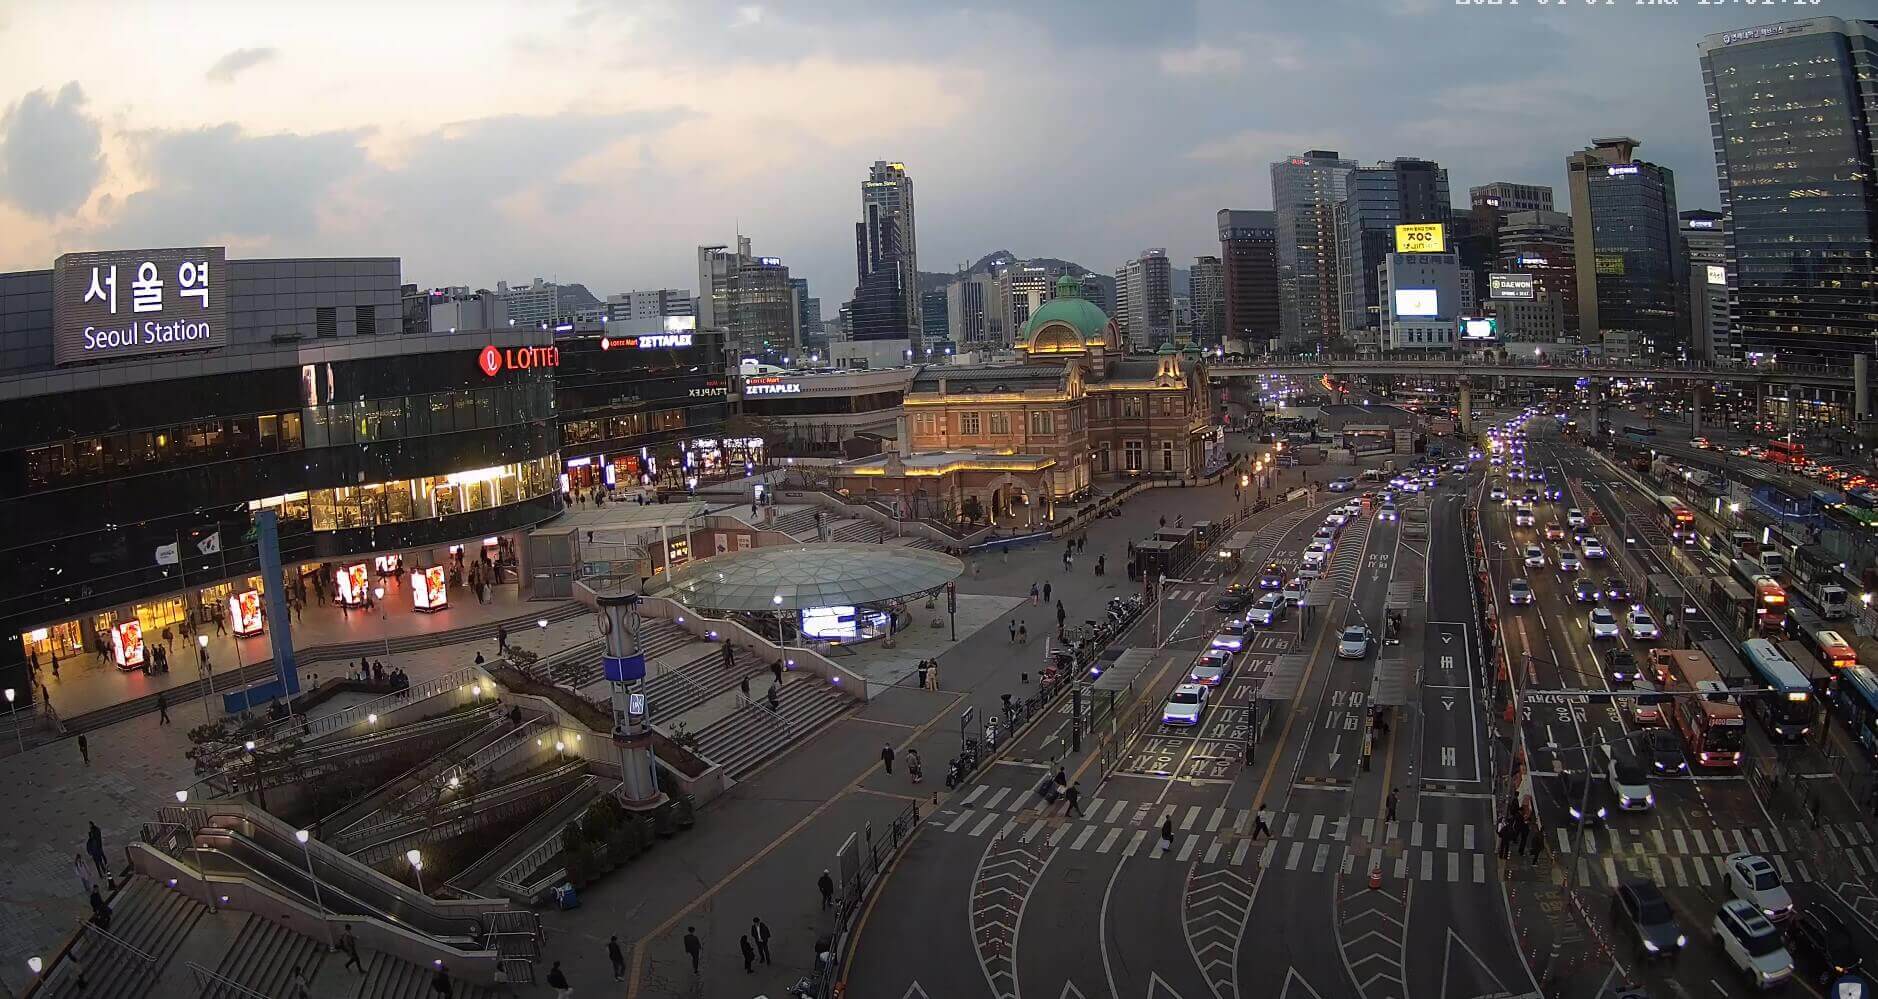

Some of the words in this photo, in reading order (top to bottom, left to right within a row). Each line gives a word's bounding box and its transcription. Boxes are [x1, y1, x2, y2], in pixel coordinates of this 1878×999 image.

[84, 261, 210, 314] 서울역
[84, 321, 139, 351] Seoul
[144, 318, 210, 344] Station
[626, 338, 638, 346] Mart
[639, 334, 692, 349] ZETTAPLEX
[506, 346, 554, 370] LOTTE
[746, 383, 800, 395] ZETTAPLEX
[1325, 711, 1359, 731] 택시
